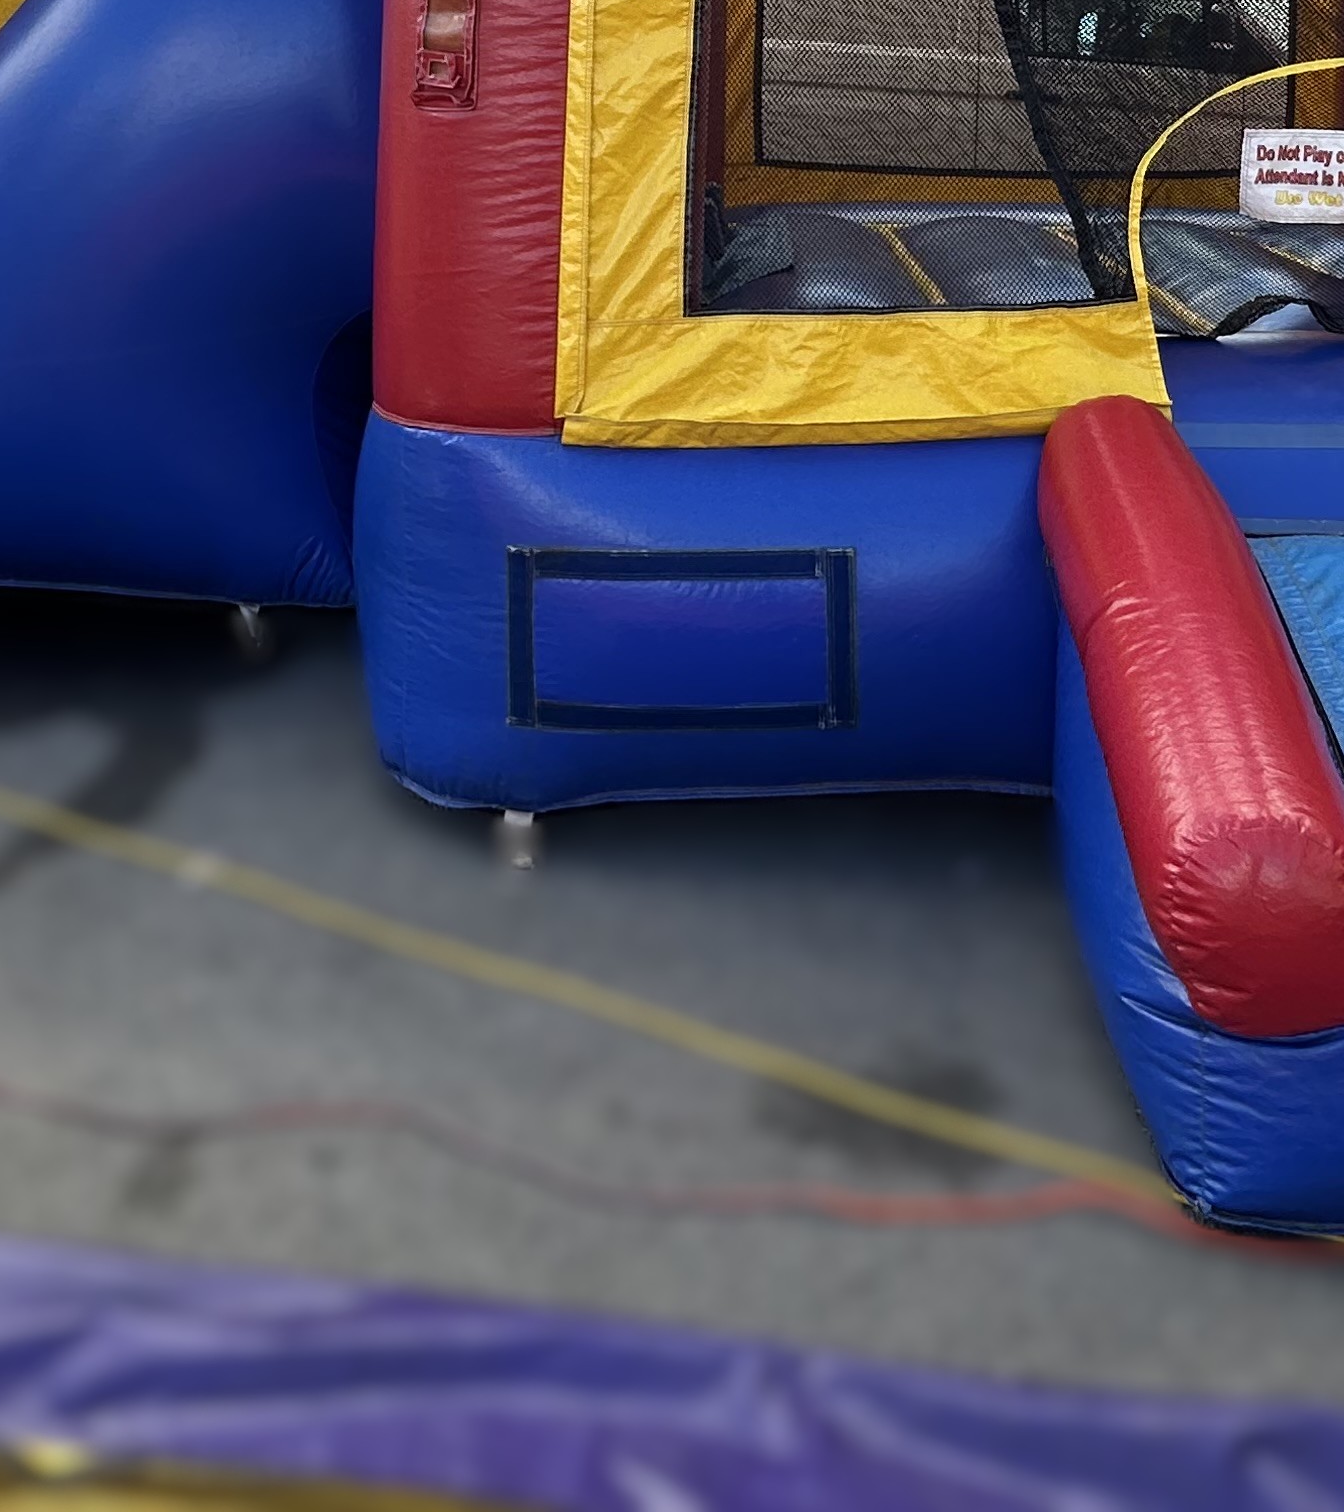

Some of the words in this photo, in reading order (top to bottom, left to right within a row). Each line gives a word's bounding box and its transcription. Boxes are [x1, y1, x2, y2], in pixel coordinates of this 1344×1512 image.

[1257, 145, 1274, 161] Do
[1278, 145, 1300, 161] Not
[1303, 145, 1332, 166] Play
[1255, 169, 1318, 185] Attendant
[1275, 191, 1302, 205] Use
[1309, 191, 1343, 206] Wet
